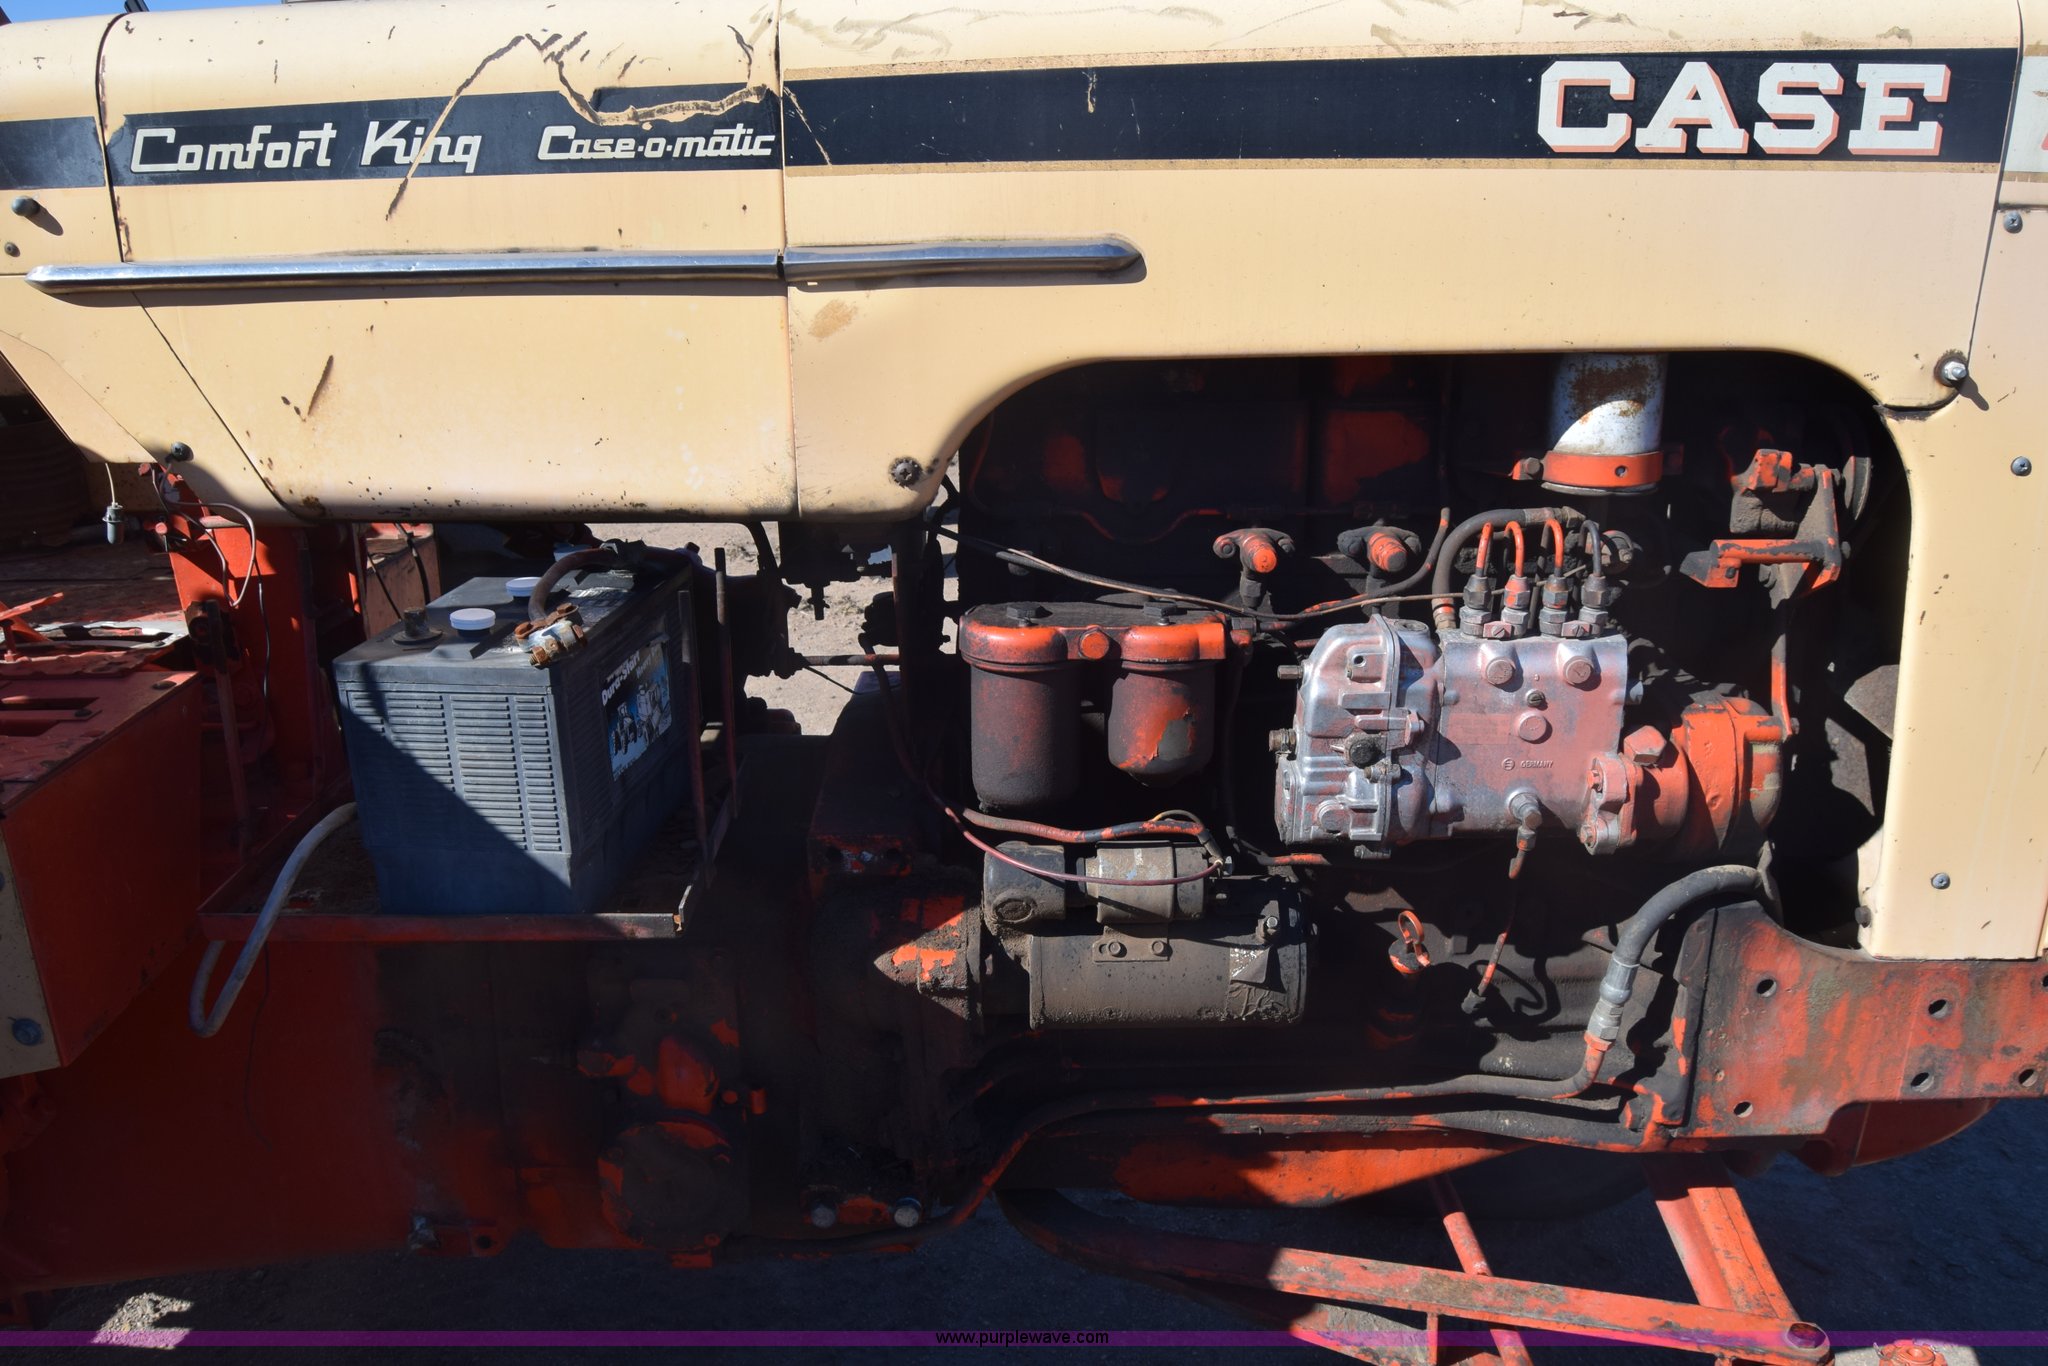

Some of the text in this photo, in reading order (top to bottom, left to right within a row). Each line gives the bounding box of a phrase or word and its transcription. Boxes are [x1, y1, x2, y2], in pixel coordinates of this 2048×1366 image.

[1538, 61, 1951, 156] CASE
[130, 120, 482, 174] Comfort King
[1520, 759, 1554, 769] GERMANY
